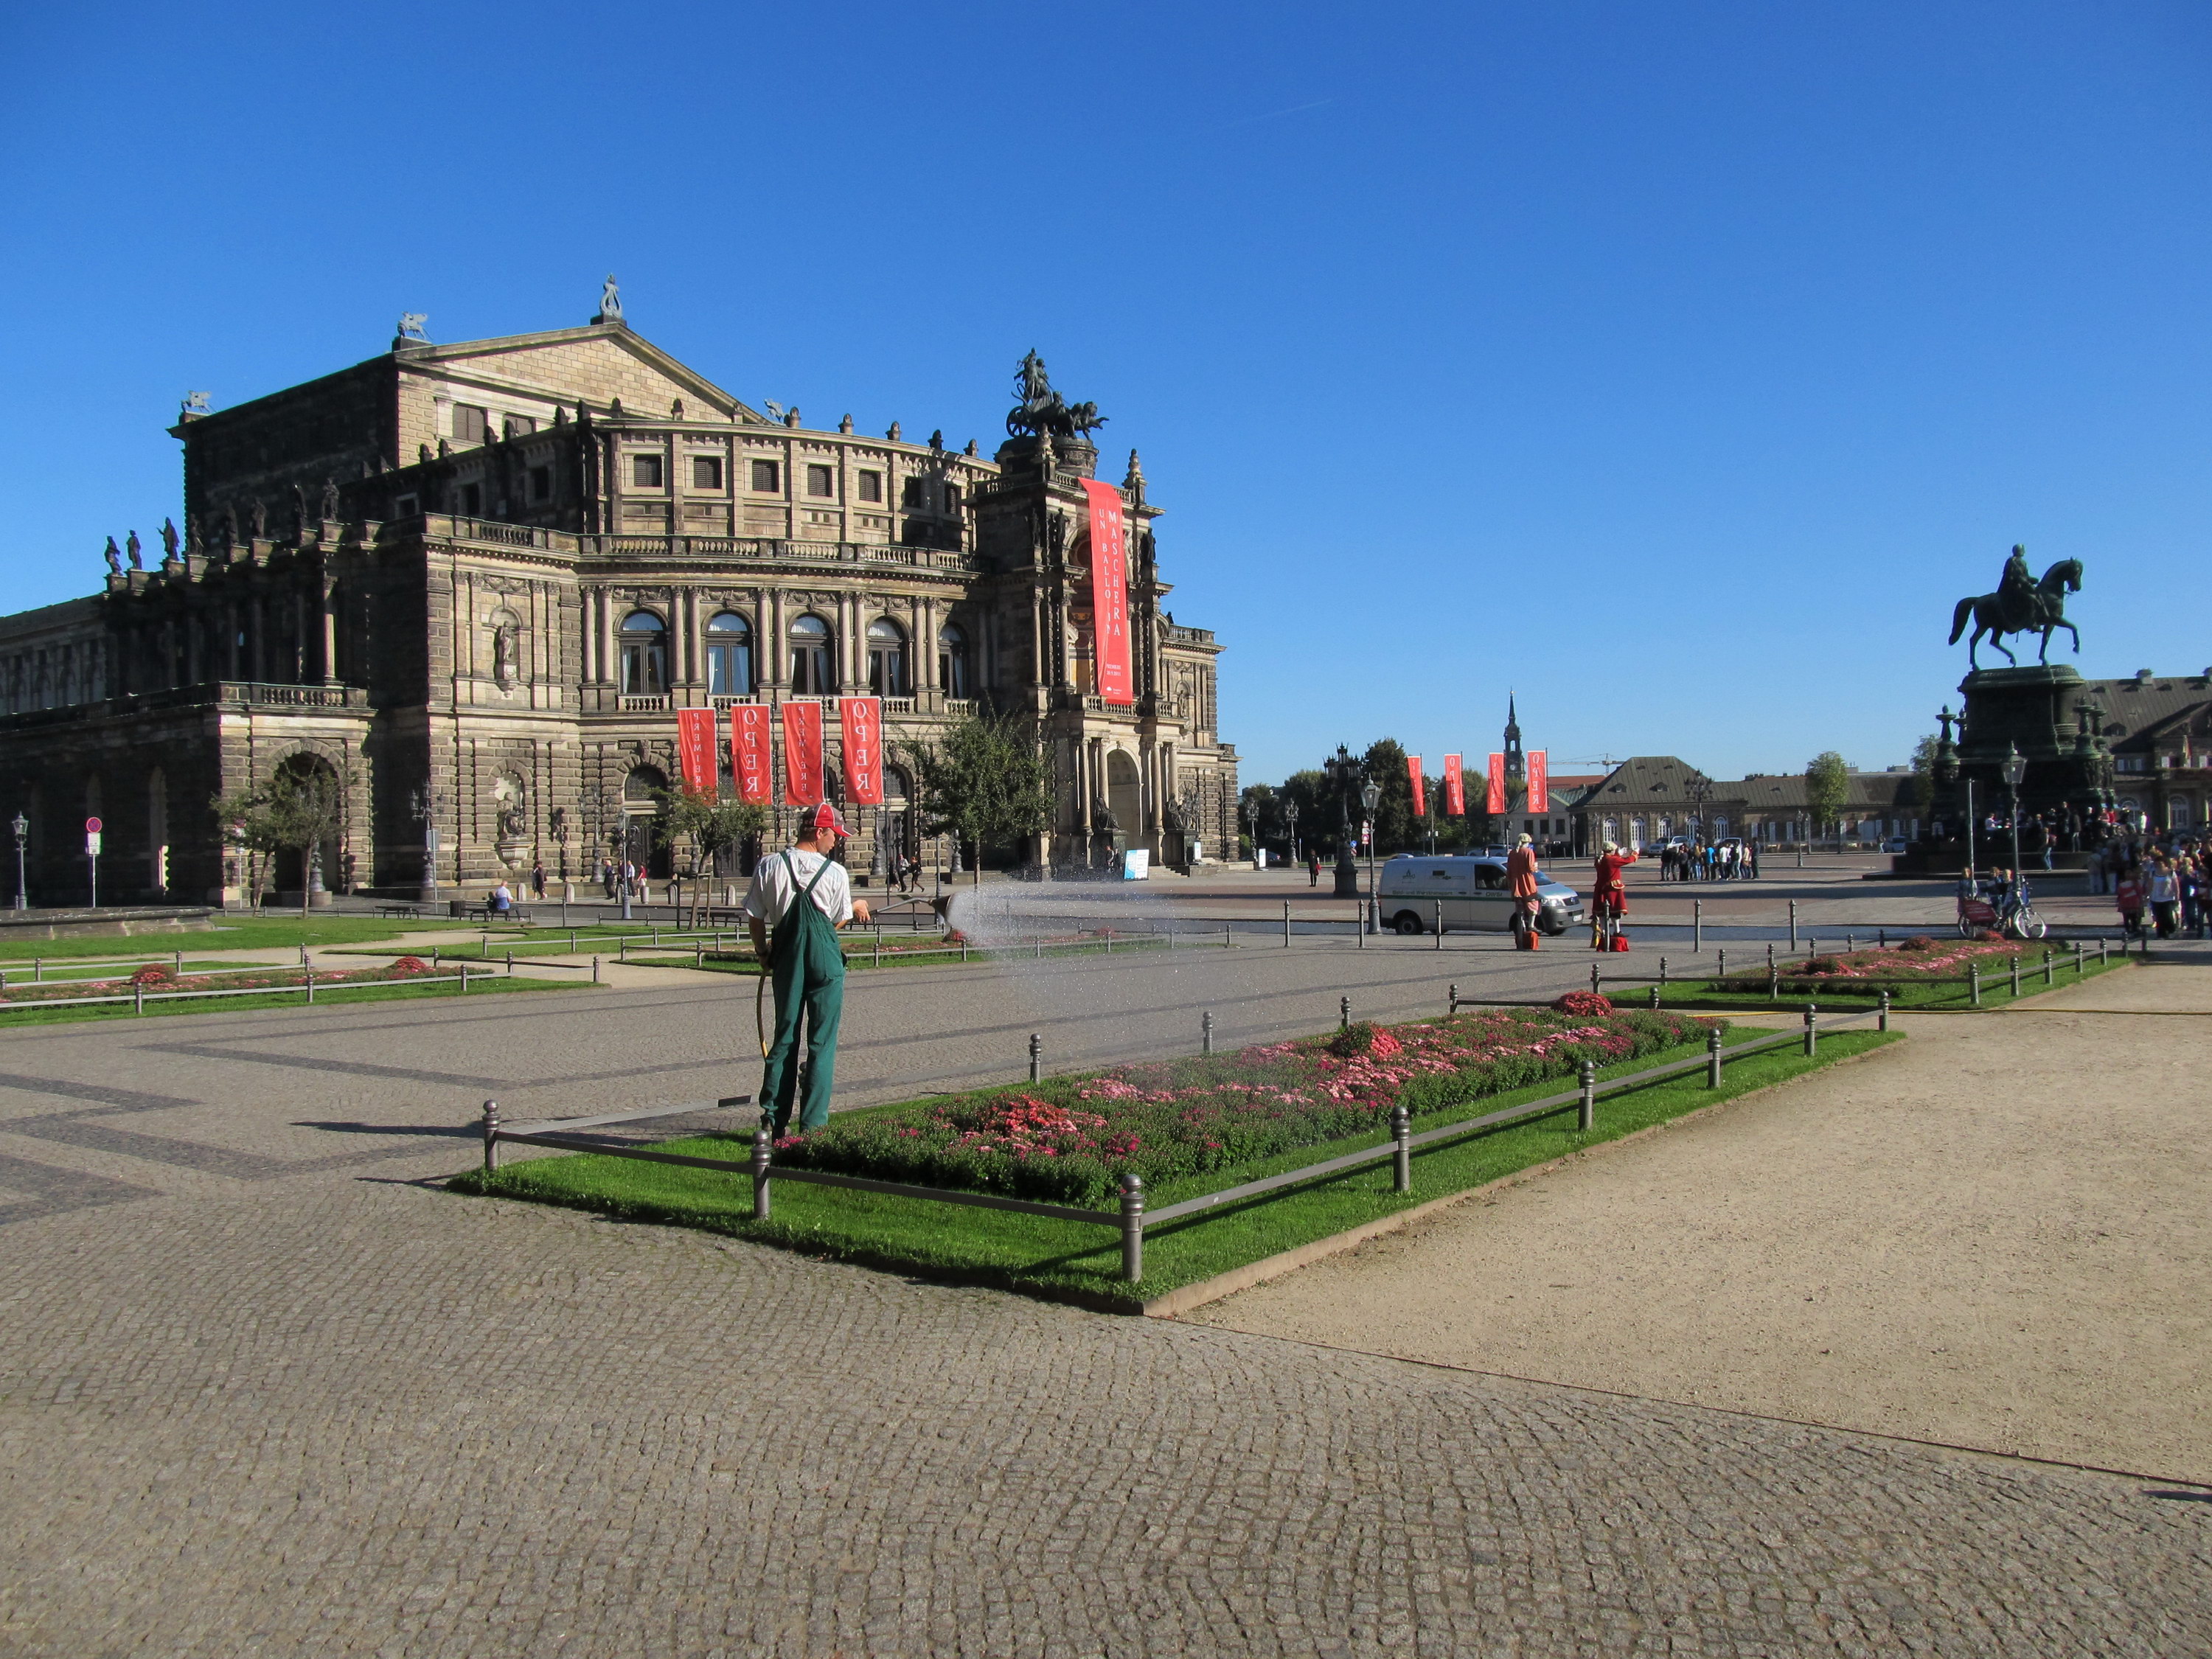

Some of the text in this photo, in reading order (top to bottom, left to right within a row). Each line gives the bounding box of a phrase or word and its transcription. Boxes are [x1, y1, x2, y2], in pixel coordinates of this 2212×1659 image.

[1099, 509, 1106, 529] UN
[1102, 543, 1111, 599] BALLO
[1108, 510, 1121, 636] MASCHERA
